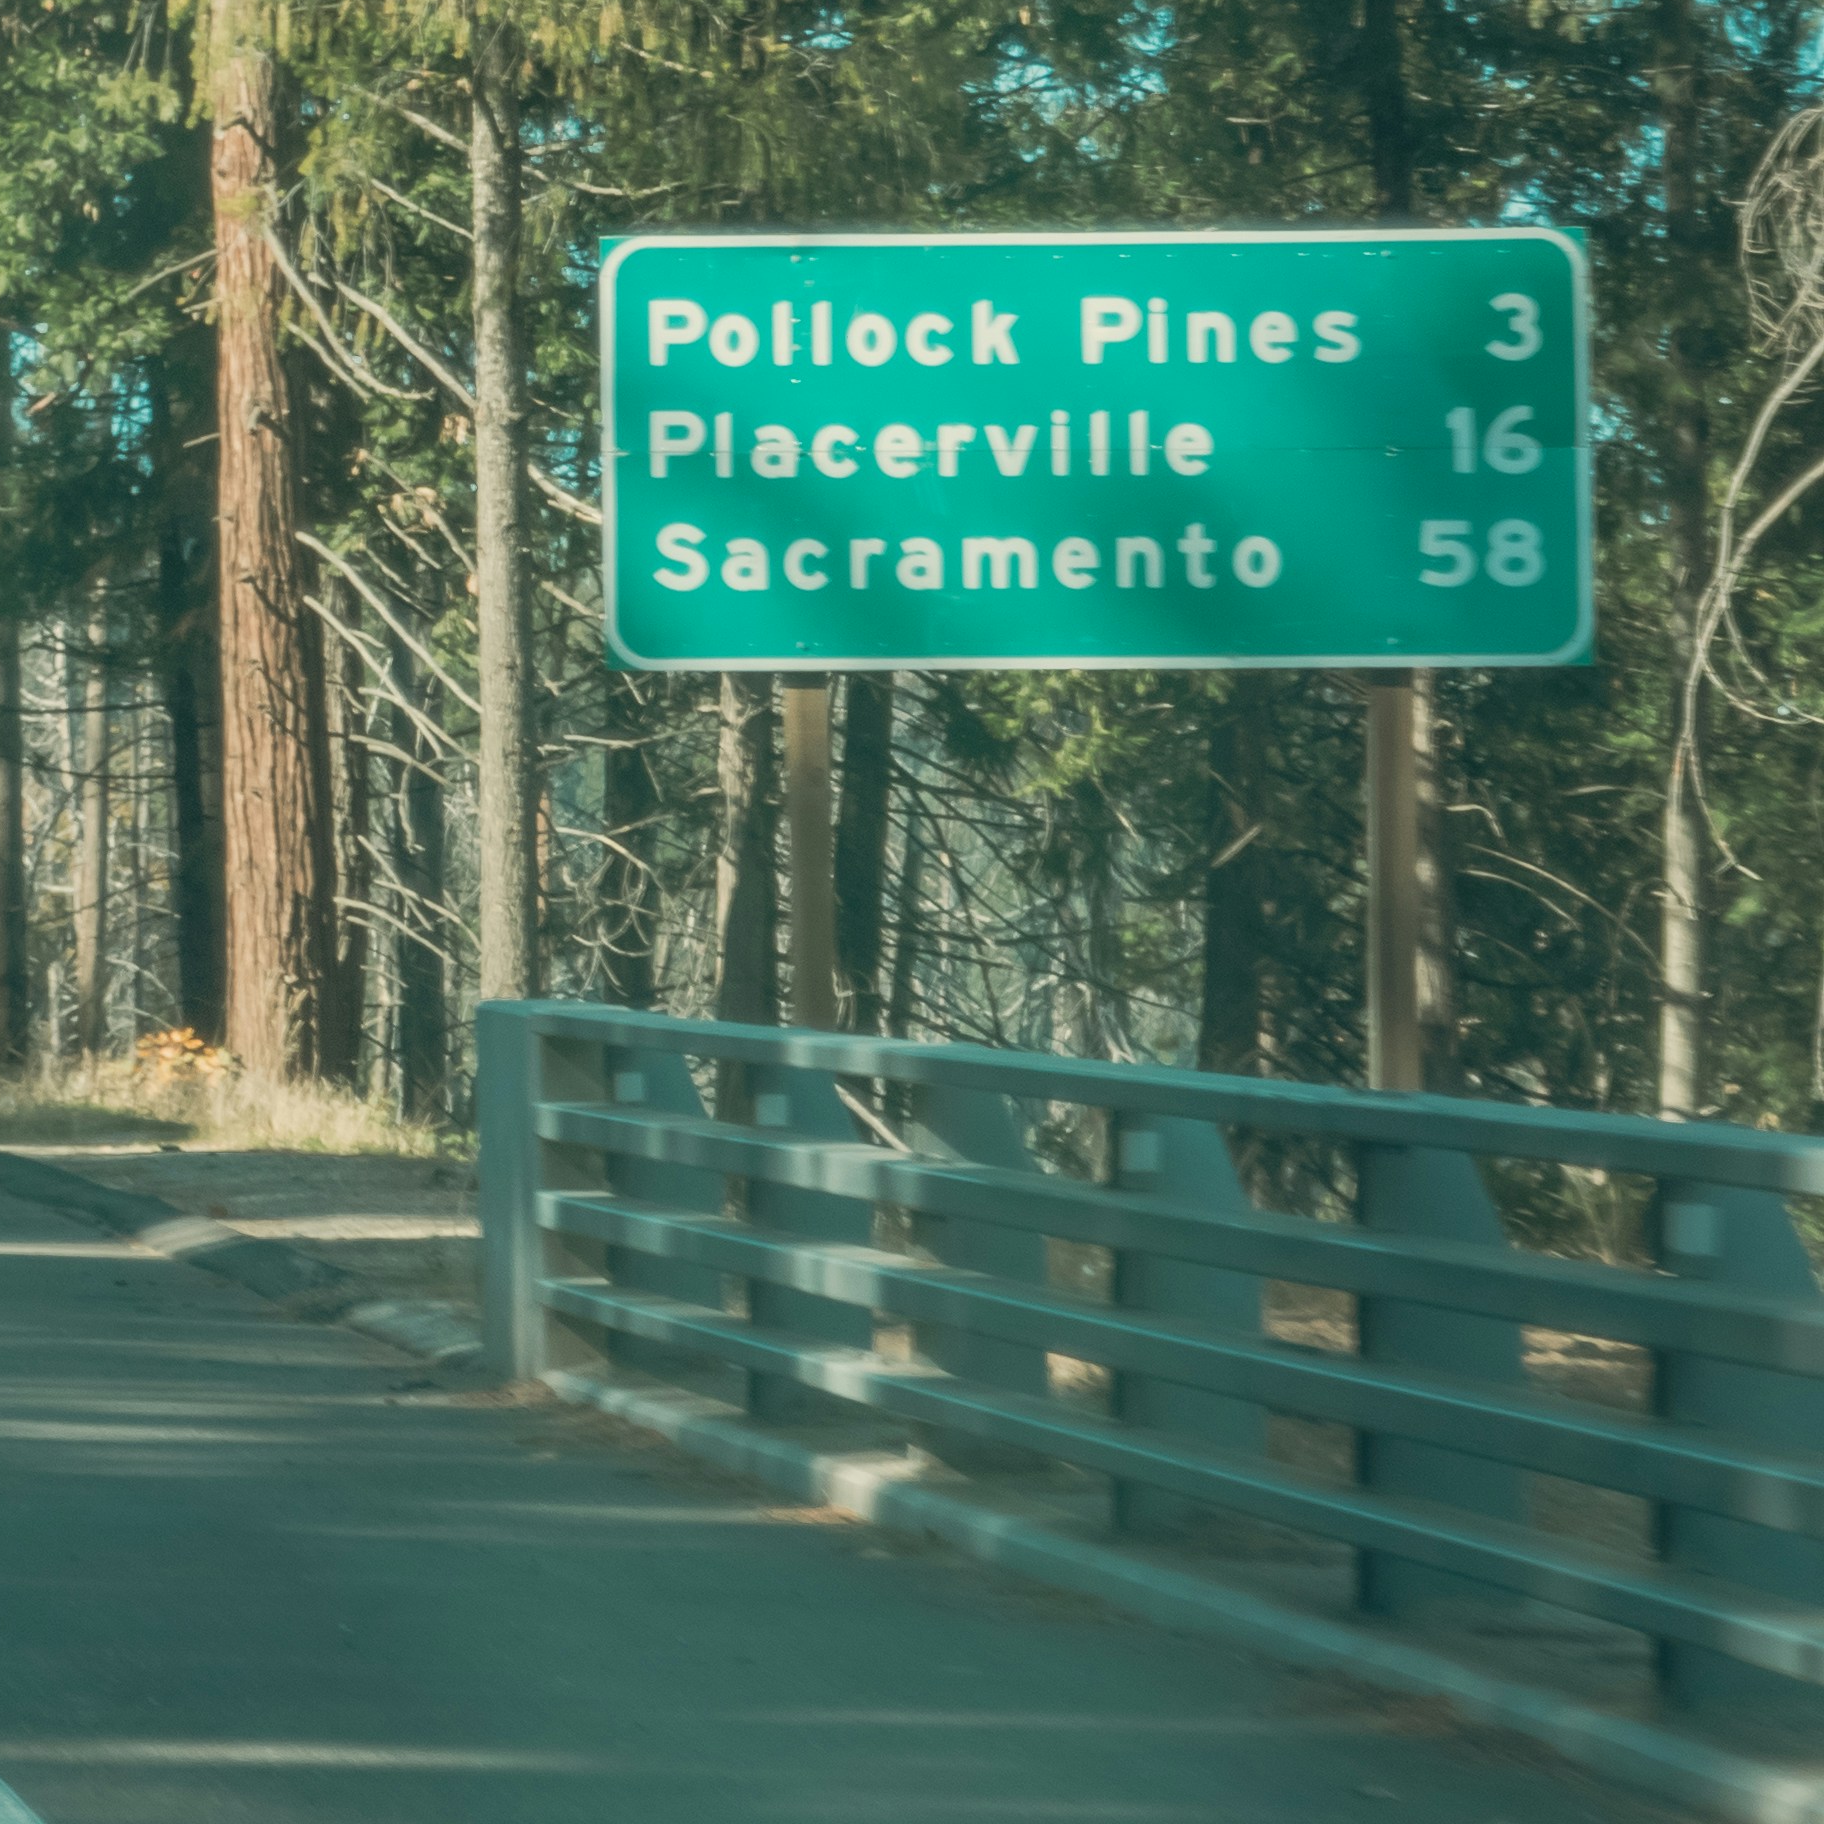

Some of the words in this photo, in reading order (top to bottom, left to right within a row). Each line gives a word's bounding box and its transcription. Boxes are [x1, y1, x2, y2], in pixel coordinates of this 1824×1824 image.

[647, 299, 1020, 366] Pollock
[1080, 296, 1362, 364] Pines
[1484, 292, 1544, 362] 3
[648, 409, 1215, 478] Placerville
[1445, 405, 1543, 474] 16
[653, 523, 1283, 591] Sacramento
[1418, 520, 1547, 588] 58
